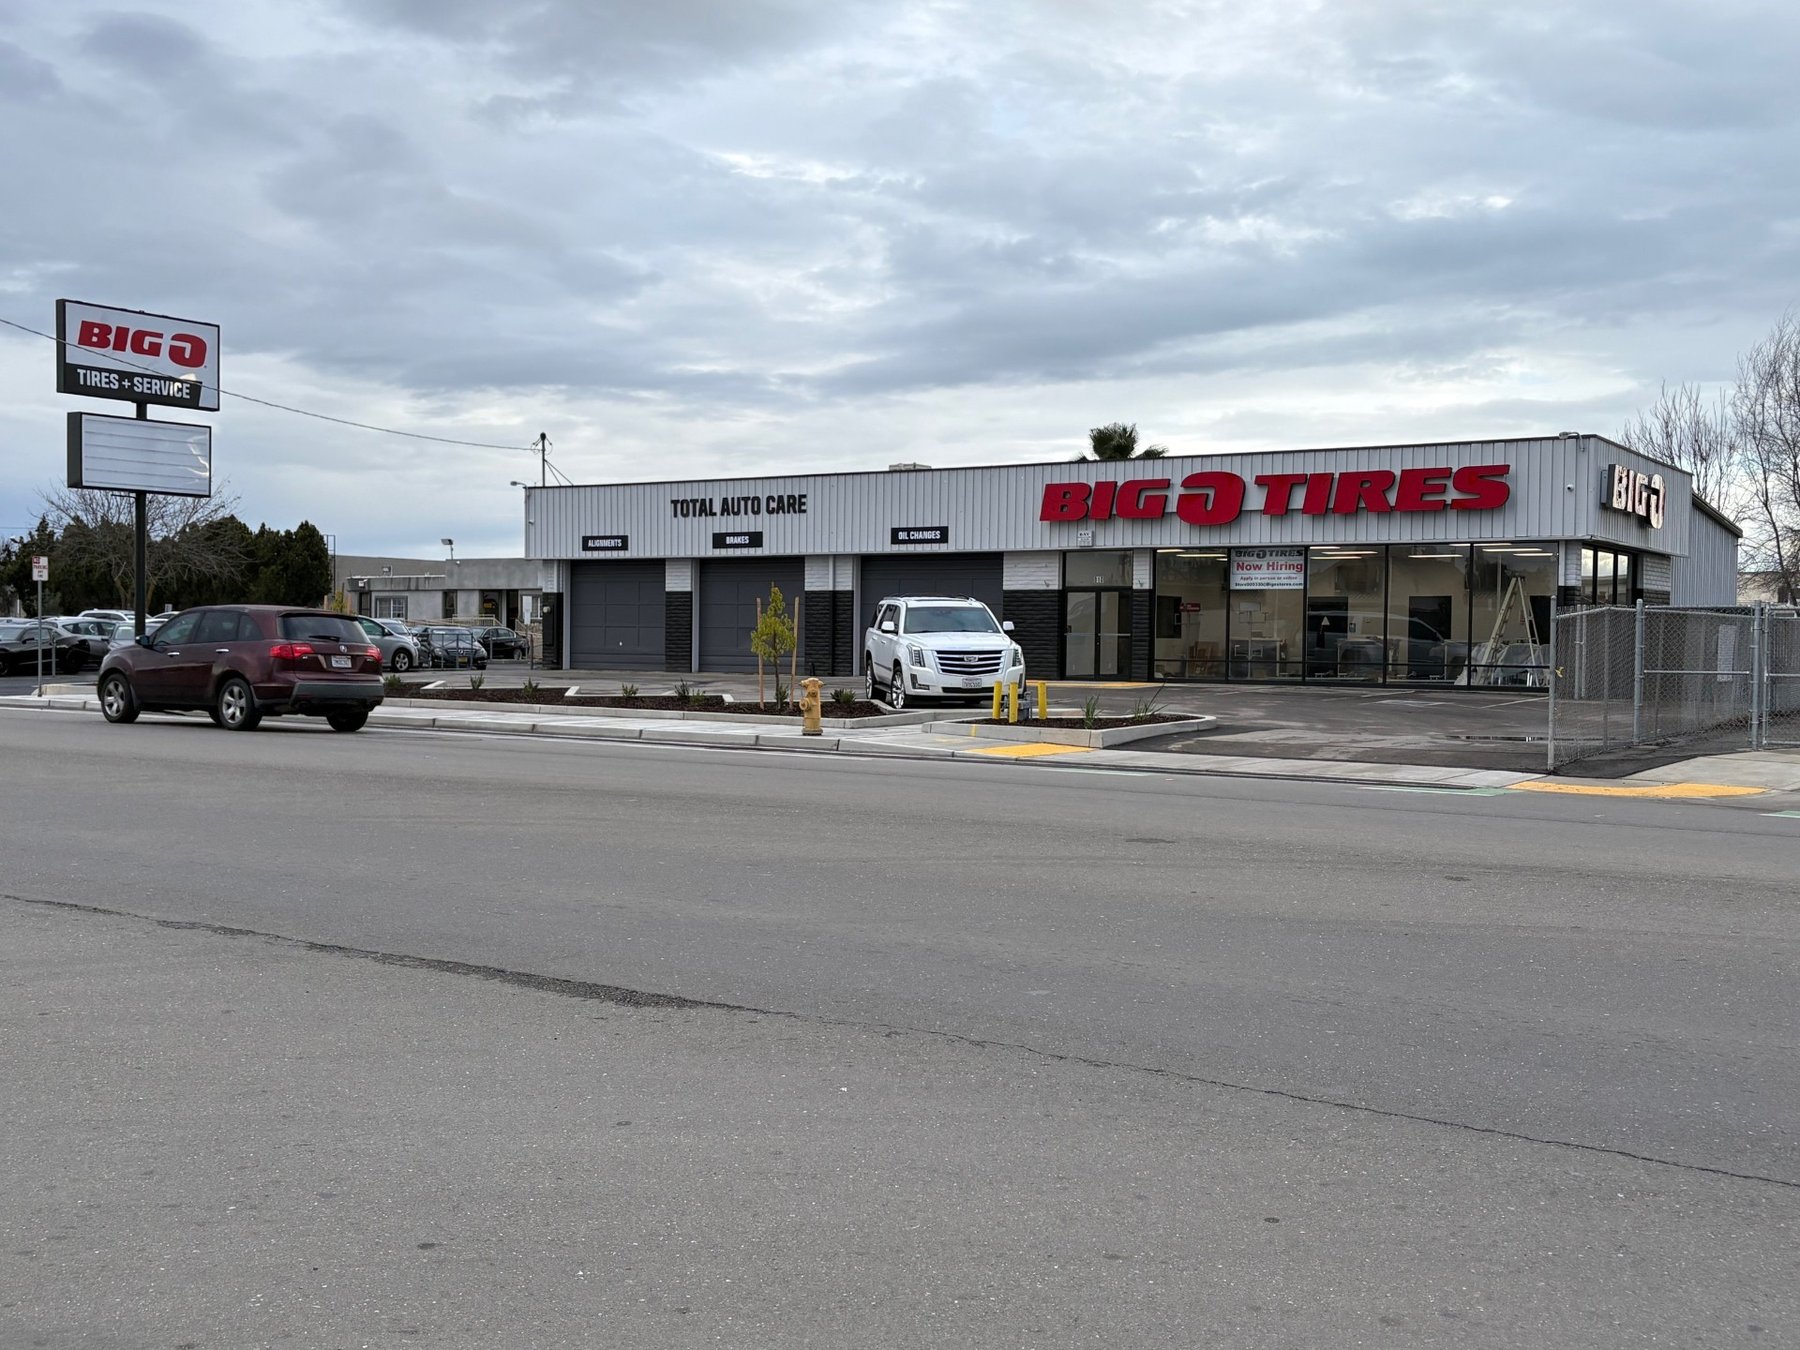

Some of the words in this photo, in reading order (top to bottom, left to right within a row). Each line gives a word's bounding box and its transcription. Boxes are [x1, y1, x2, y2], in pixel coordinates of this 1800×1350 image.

[78, 320, 163, 357] BIG
[77, 368, 119, 390] TIRES
[134, 376, 190, 399] SERVICE
[1039, 478, 1171, 522] BIG
[1254, 464, 1510, 516] TIRES
[1612, 464, 1649, 517] BIG
[671, 498, 717, 518] TOTAL
[720, 496, 761, 517] AUTO
[765, 494, 807, 515] CARE
[588, 539, 622, 548] ALIGNMENTS
[726, 536, 750, 545] BRAKES
[898, 531, 909, 540] OIL
[910, 530, 941, 540] CHANGES
[1235, 549, 1256, 558] BIG
[1268, 549, 1303, 557] TIRES
[1236, 562, 1262, 571] Now
[1266, 561, 1303, 573] Hiring
